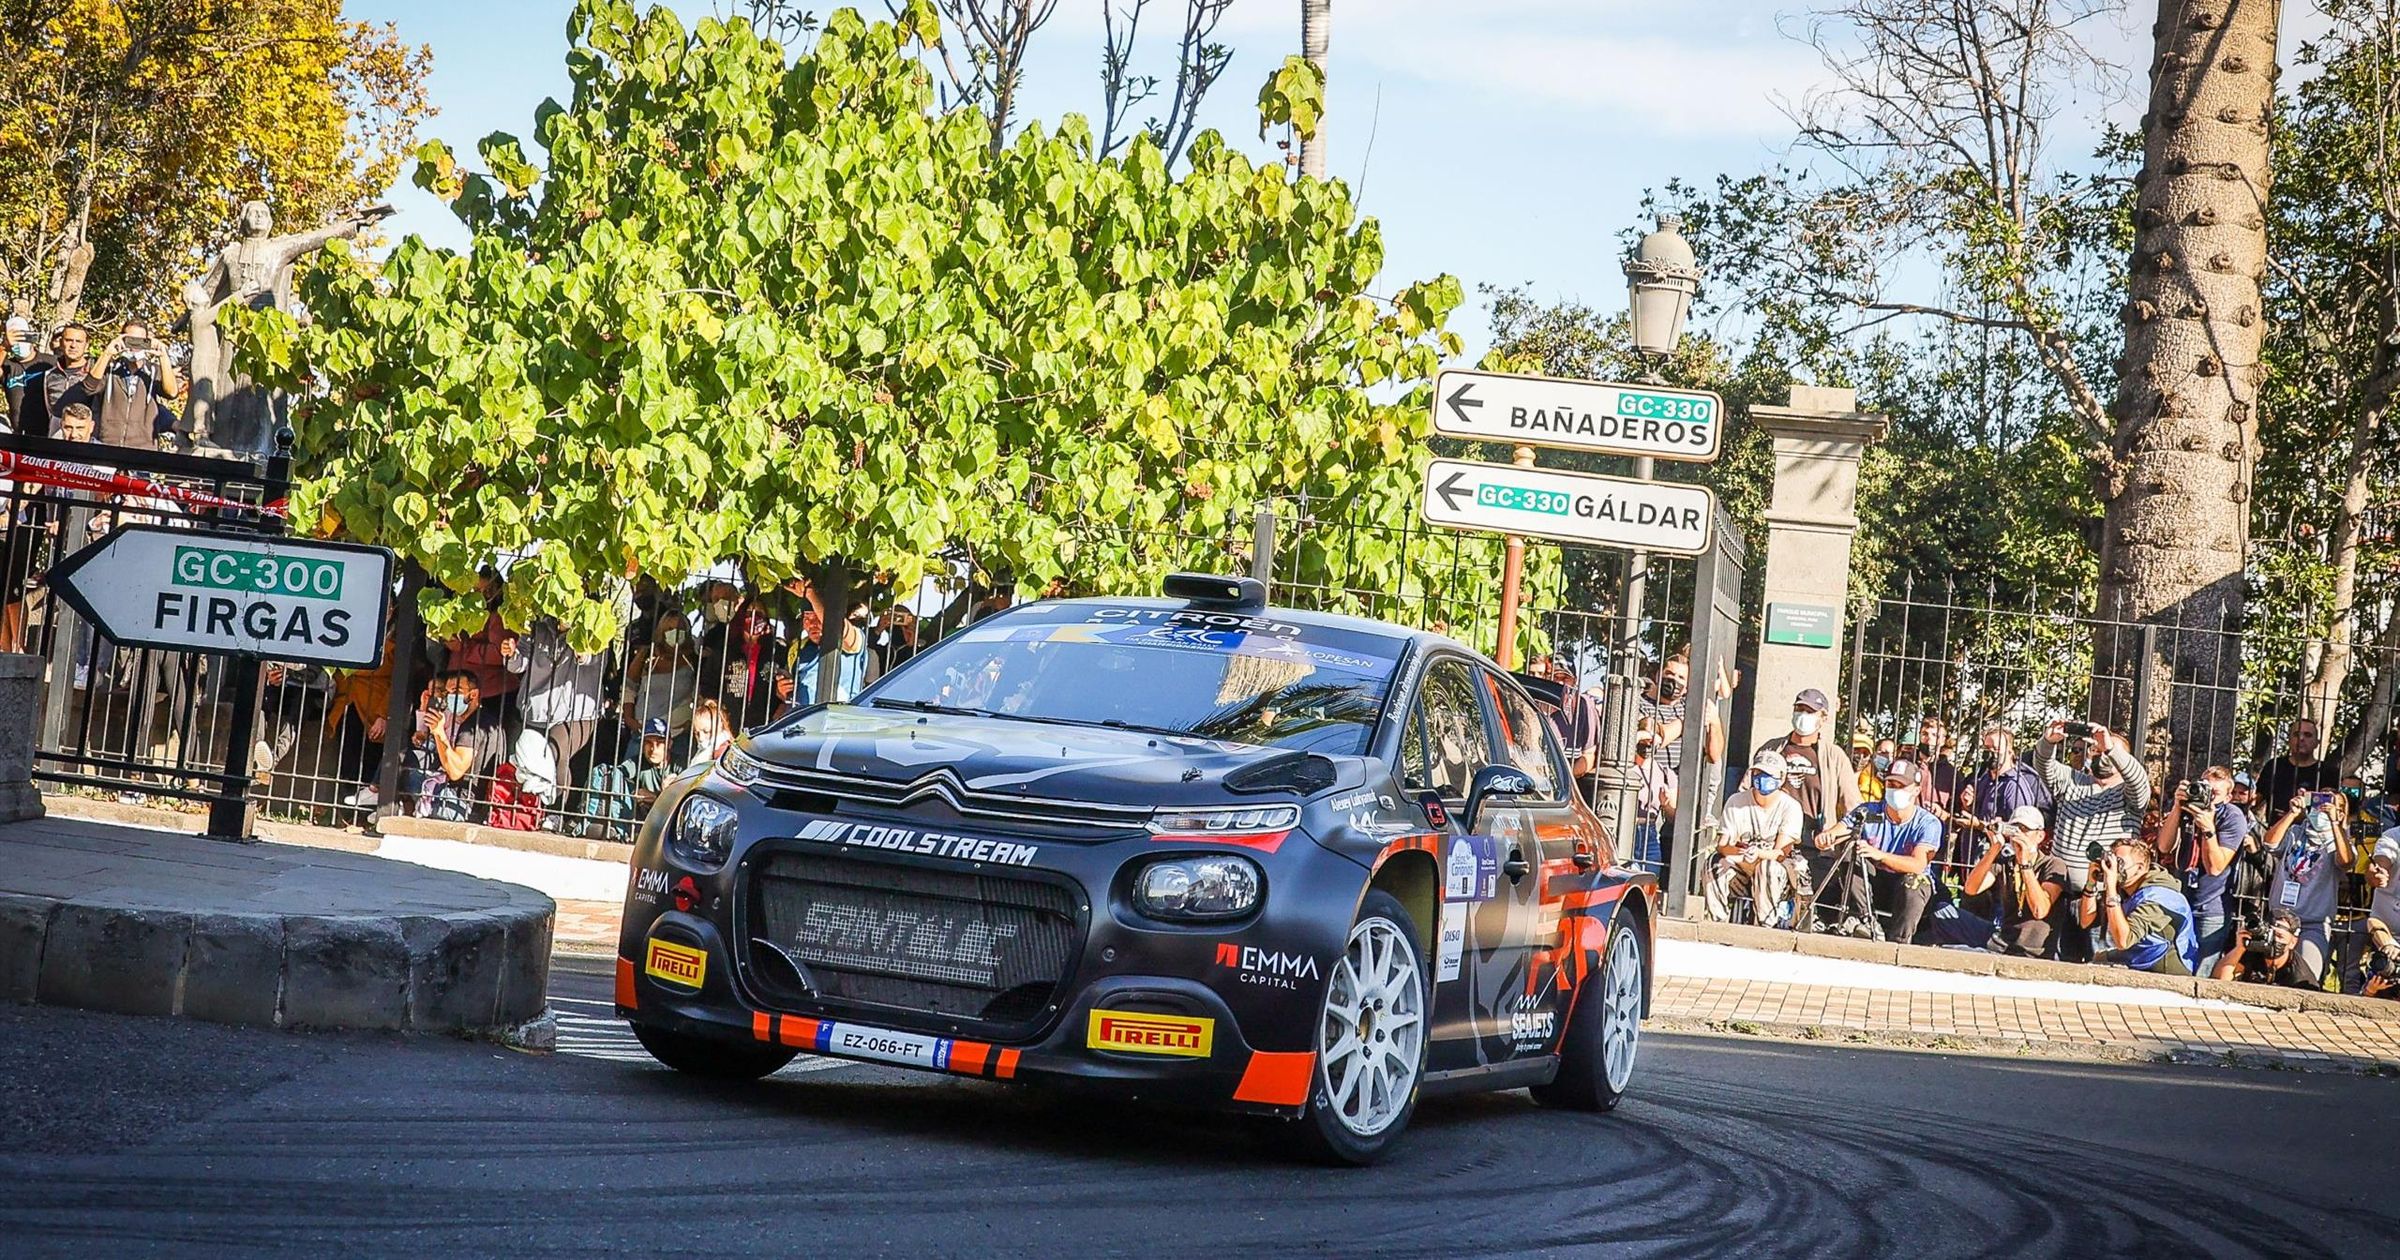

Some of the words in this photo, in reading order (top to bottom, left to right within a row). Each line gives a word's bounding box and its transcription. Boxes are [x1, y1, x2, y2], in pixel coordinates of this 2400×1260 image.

[1620, 395, 1710, 420] GC-330
[1510, 406, 1708, 446] BAÑADEROS
[20, 454, 52, 469] ZONA
[53, 460, 115, 483] PROHIBIDA
[1479, 485, 1568, 514] GC-330
[1574, 493, 1701, 531] GÁLDAR
[177, 551, 340, 596] GC-300
[154, 592, 351, 648] FIRGAS
[1304, 650, 1375, 668] LOPESAN
[846, 824, 1038, 867] COOLSTREAM
[638, 868, 669, 895] EMMA
[634, 892, 657, 905] CAPITAL
[651, 945, 700, 980] PIRELLI
[1242, 946, 1320, 981] EMMA
[1239, 973, 1297, 991] CAPITAL
[822, 1023, 830, 1032] F
[843, 1033, 923, 1058] EZ-066-FT
[1099, 1017, 1203, 1049] PIRELLI
[1512, 1011, 1555, 1040] SEAJETS
